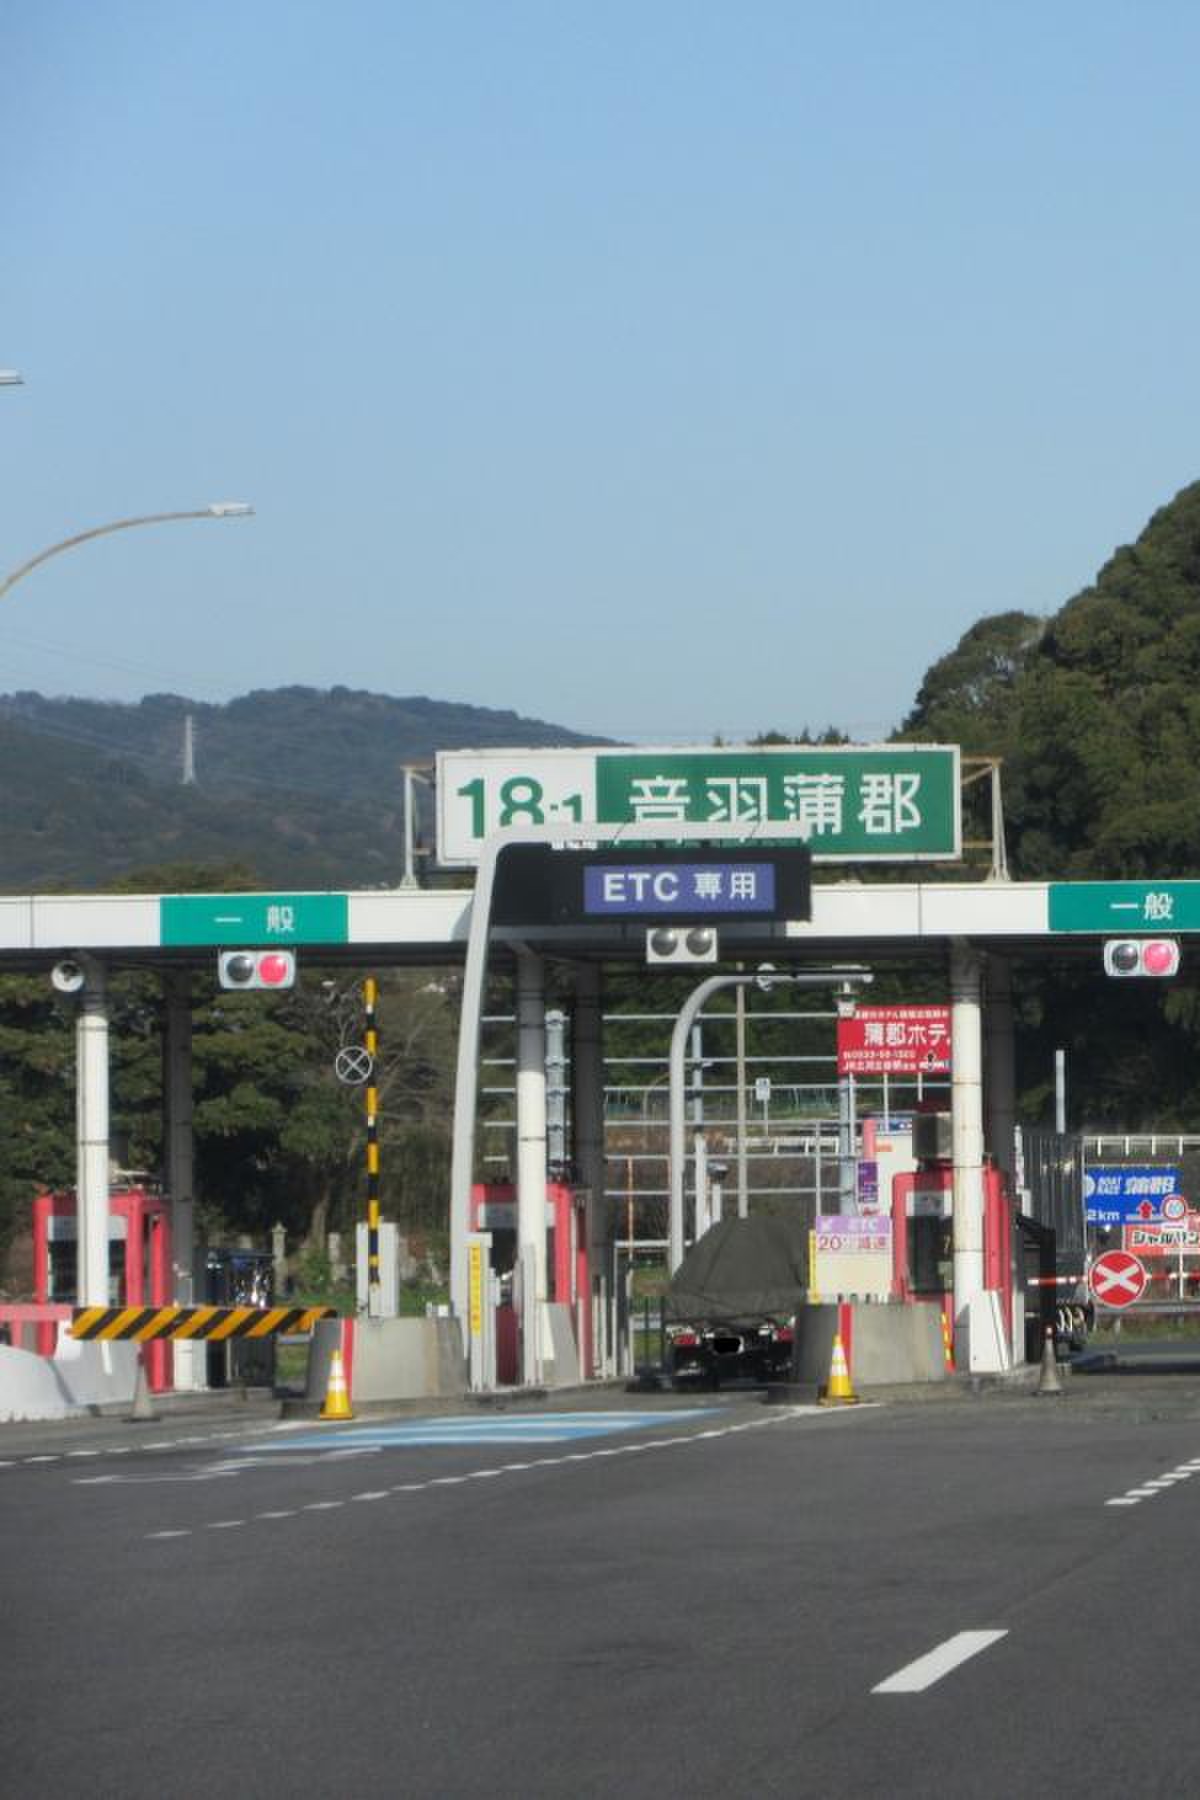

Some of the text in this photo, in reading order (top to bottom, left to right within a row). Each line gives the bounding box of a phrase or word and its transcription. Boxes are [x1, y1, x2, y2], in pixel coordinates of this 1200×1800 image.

[629, 774, 921, 834] 音羽蒲郡
[604, 871, 756, 901] ETC 専用
[214, 904, 295, 934] 一般
[1110, 892, 1173, 920] 一般
[864, 1022, 951, 1047] 蒲郡ホテ
